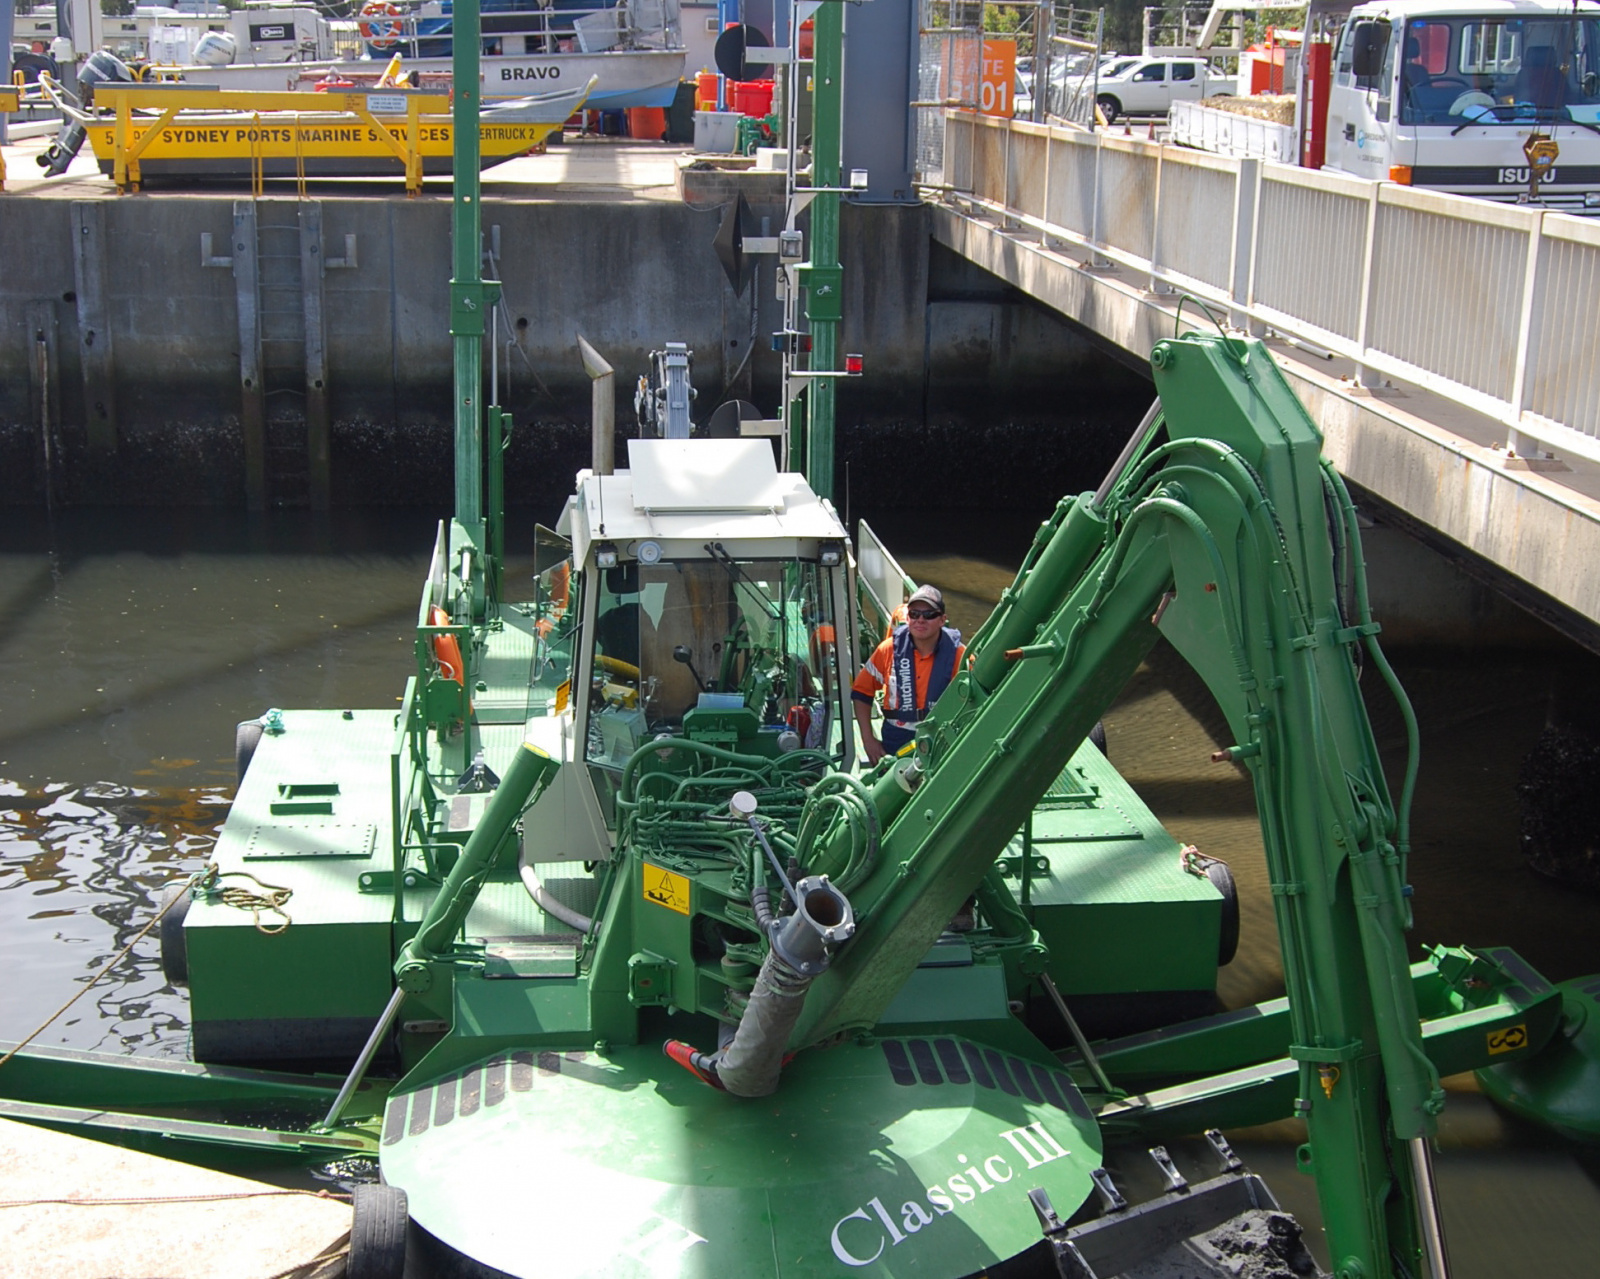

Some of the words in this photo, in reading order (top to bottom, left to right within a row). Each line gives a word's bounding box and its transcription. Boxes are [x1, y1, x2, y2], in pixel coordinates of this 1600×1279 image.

[501, 66, 560, 80] BRAVO
[162, 130, 229, 143] SYDNEY
[236, 130, 291, 142] PORTS
[298, 129, 362, 142] MARINE
[368, 128, 449, 141] SRVCES
[479, 127, 526, 140] ERTRUCK
[529, 128, 535, 140] 2
[1498, 168, 1556, 183] ISUU
[899, 658, 913, 712] Hutchwilco
[830, 1153, 1013, 1267] Classic
[998, 1121, 1071, 1170] III
